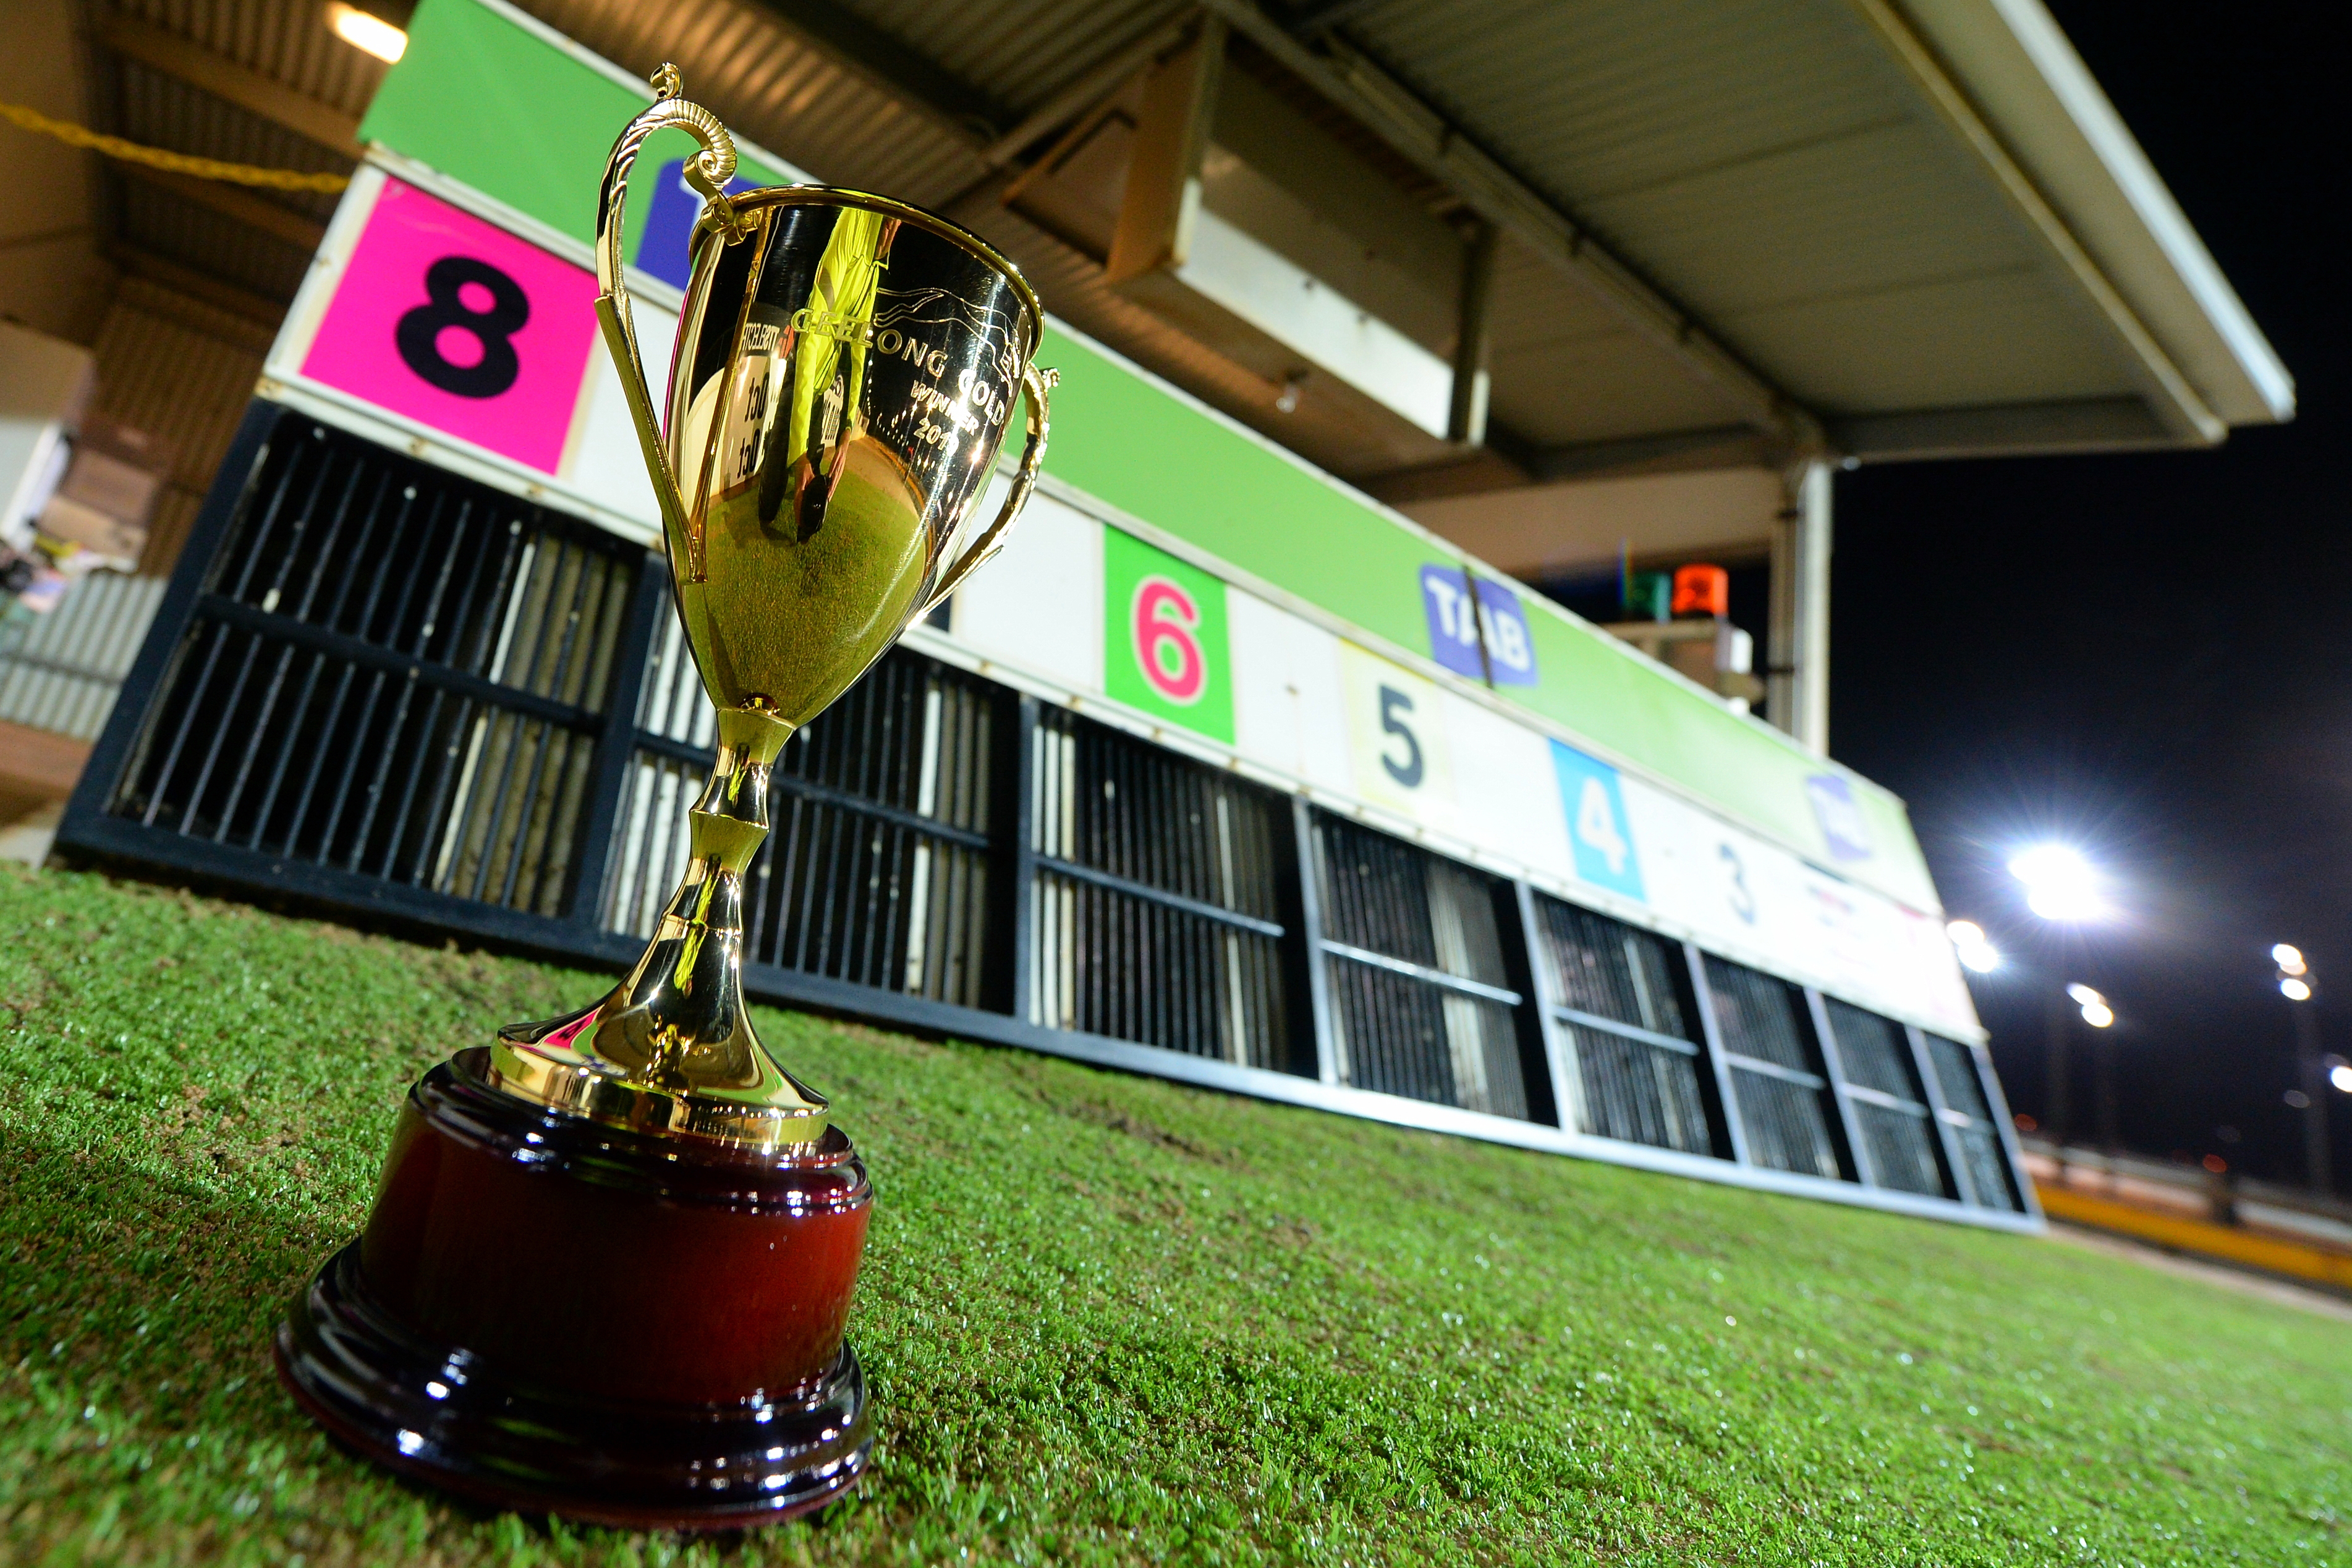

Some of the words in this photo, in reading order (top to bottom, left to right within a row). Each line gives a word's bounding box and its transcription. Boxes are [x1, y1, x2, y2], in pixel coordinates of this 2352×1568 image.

[396, 255, 530, 399] 8
[791, 308, 949, 378] GEELONG
[958, 368, 1006, 426] GOLD
[910, 379, 979, 436] WINNER
[1132, 575, 1206, 706] 6
[1425, 575, 1530, 672] TAB
[1379, 684, 1424, 789] 5
[1576, 774, 1628, 876] 4
[1718, 842, 1757, 925] 3
